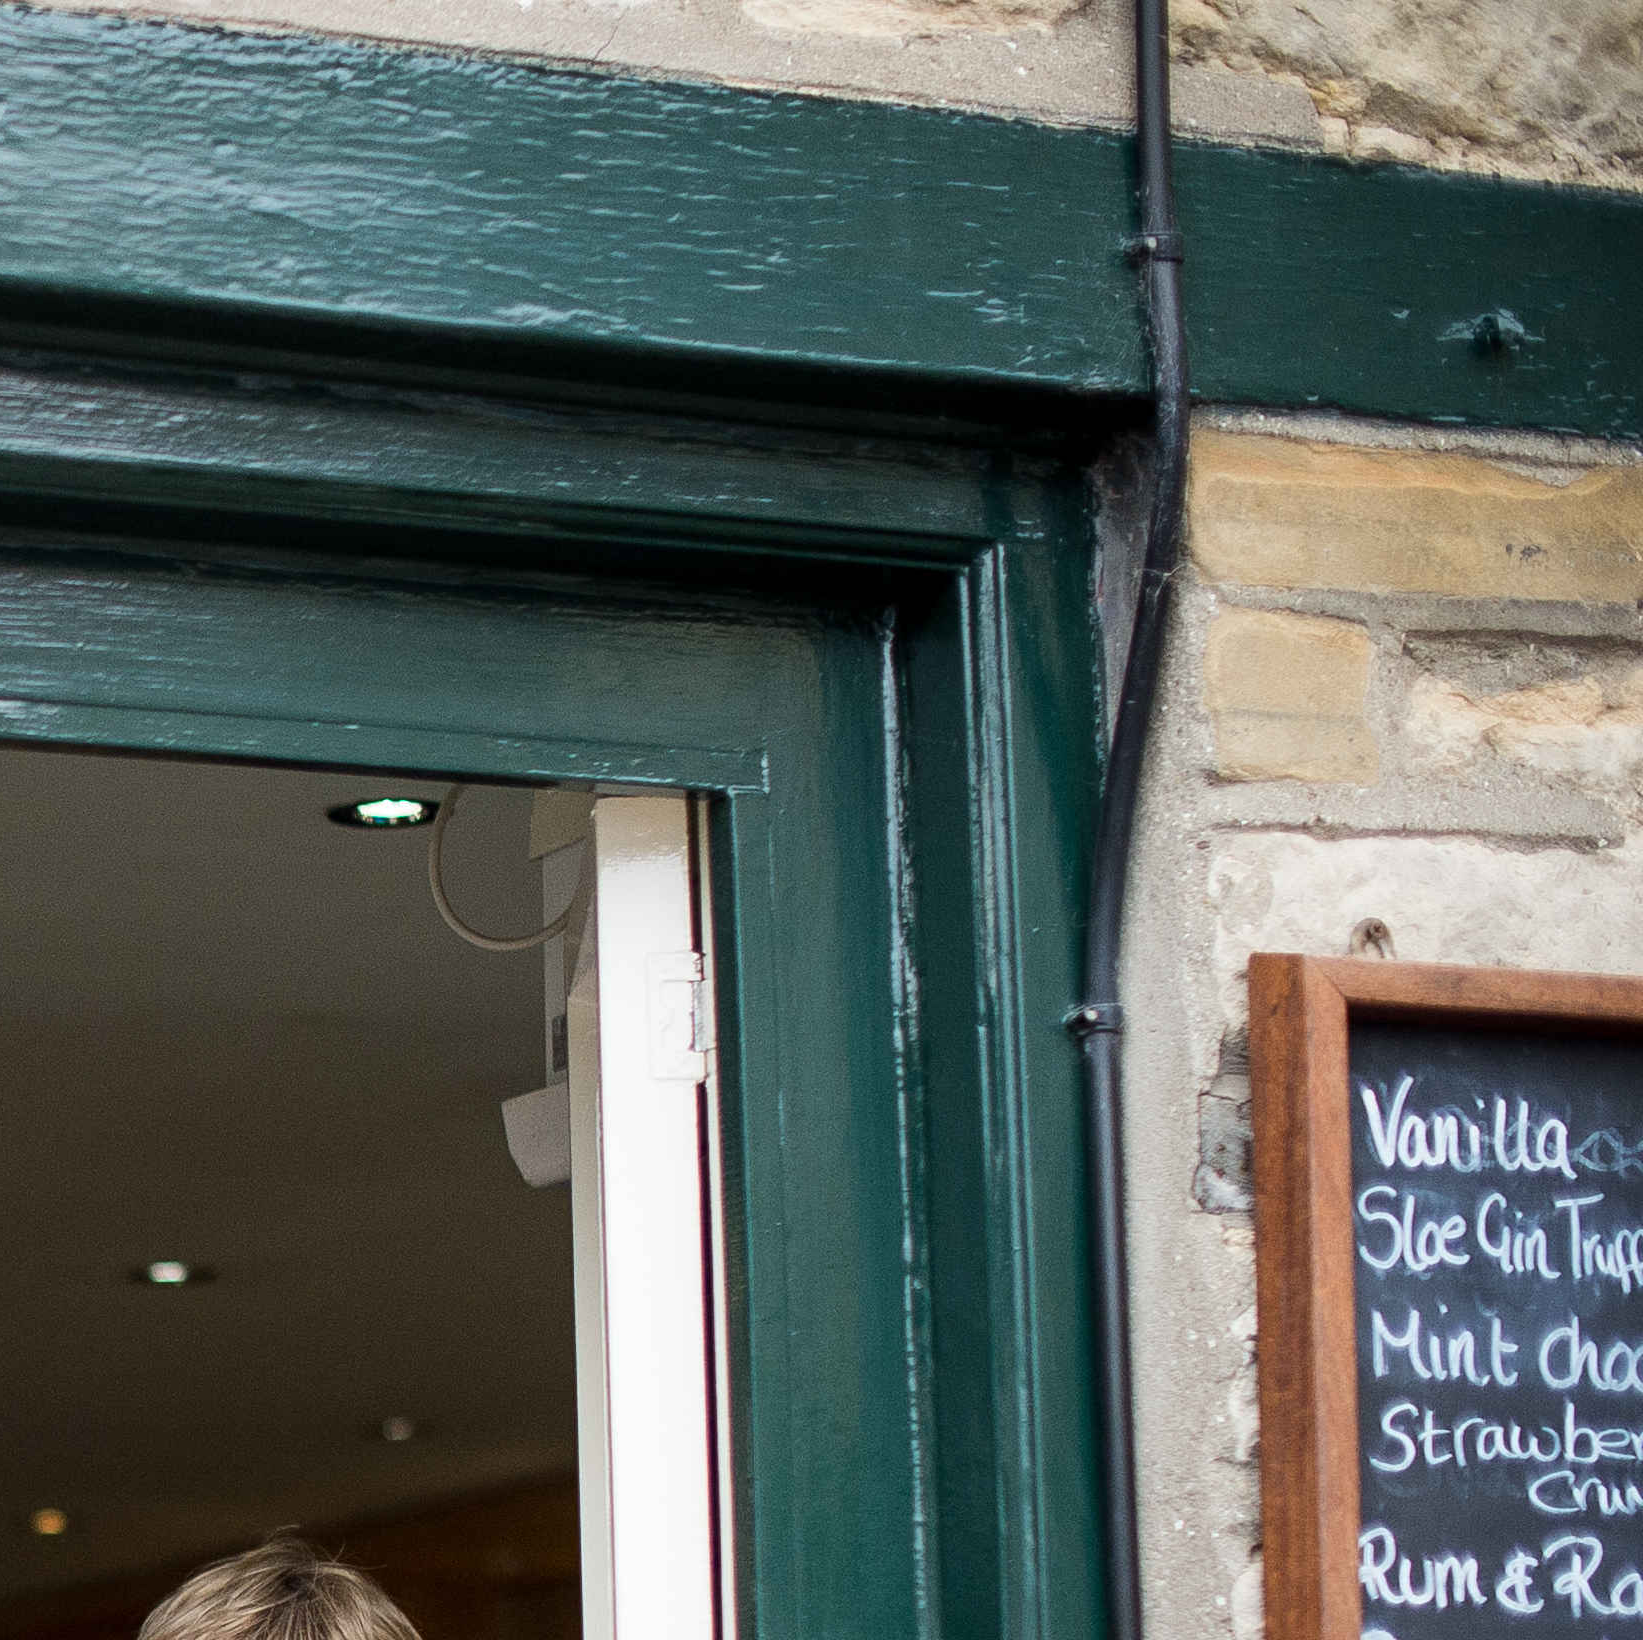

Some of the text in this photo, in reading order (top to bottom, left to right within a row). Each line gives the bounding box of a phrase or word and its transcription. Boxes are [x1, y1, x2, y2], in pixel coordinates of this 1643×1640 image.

[1361, 1076, 1578, 1179] Vanilla
[1357, 1185, 1472, 1272] Sloe
[1476, 1192, 1562, 1279] Gin
[1371, 1304, 1519, 1387] Mint
[1358, 1528, 1487, 1609] Rum
[1495, 1551, 1545, 1614] &
